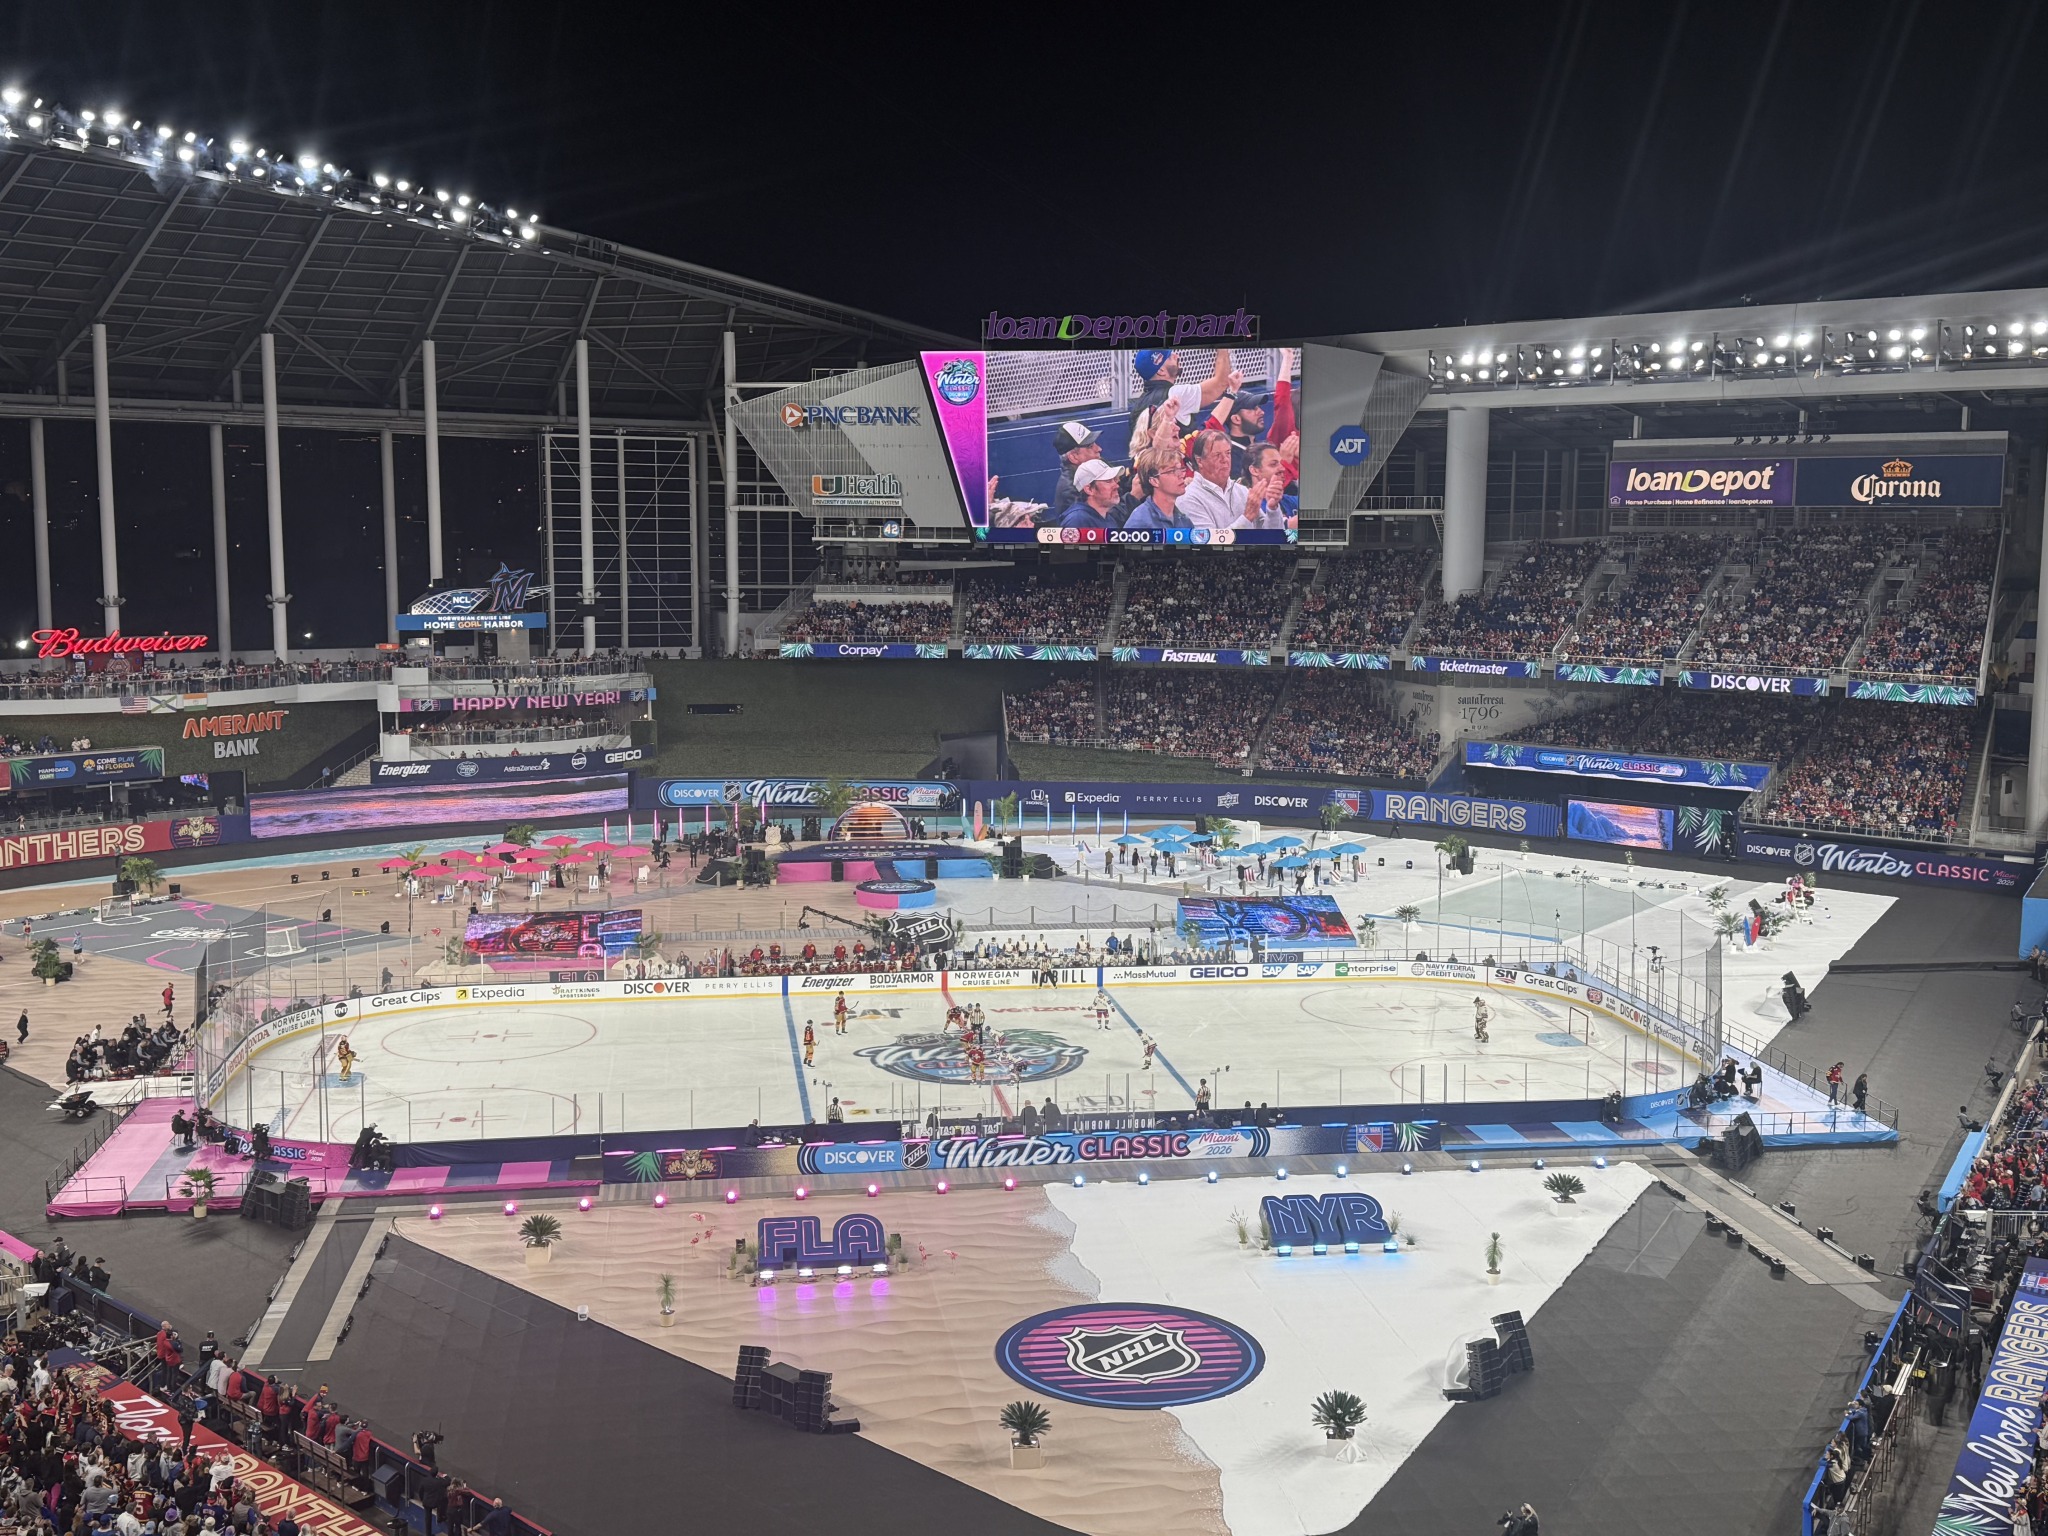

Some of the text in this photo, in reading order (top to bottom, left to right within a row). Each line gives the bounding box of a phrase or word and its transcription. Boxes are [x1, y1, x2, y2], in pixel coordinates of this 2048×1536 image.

[986, 308, 1254, 346] loanDepot park
[934, 371, 980, 388] Winter
[1334, 438, 1366, 454] ADT
[1626, 465, 1775, 497] loanDepot
[1850, 474, 1942, 504] Corona
[884, 524, 898, 534] 42
[1087, 530, 1096, 541] 0
[1110, 530, 1150, 542] 20:00
[1174, 530, 1183, 542] 0
[1219, 535, 1226, 543] 0
[452, 596, 471, 604] NCL
[484, 620, 524, 628] HARBOR
[32, 628, 208, 659] Budweiser
[1440, 660, 1508, 675] ticketmaster
[1710, 674, 1791, 693] DISCOVER
[452, 697, 520, 711] HAPPY
[527, 694, 568, 709] NEW
[572, 691, 620, 706] YEAR!
[183, 710, 285, 738] AMERANT
[214, 738, 260, 758] BANK
[604, 750, 642, 764] GEICO
[1577, 755, 1621, 771] Winter
[1622, 761, 1660, 773] CLASSIC
[379, 764, 431, 778] Energizer
[674, 788, 718, 798] DISCOVER
[911, 787, 941, 796] Miami
[1078, 792, 1120, 803] Expedia
[1254, 796, 1308, 808] DISCOVER
[1386, 794, 1527, 832] RANGERS
[1747, 844, 1791, 858] DISCOVER
[1817, 844, 1914, 878] Winter
[1916, 862, 1990, 882] CLASSIC
[1993, 870, 2020, 880] Miami
[954, 971, 1020, 980] NORWEGIAN
[1124, 969, 1177, 979] MassMutual
[1190, 966, 1248, 979] GEICO
[1262, 966, 1282, 976] SAP
[1298, 966, 1317, 976] SAP
[1338, 964, 1397, 976] enterprise
[802, 976, 854, 990] Energizer
[870, 973, 935, 985] BODYARMOR
[1524, 975, 1578, 995] Great Clips
[472, 986, 525, 1000] Expedia
[624, 982, 690, 995] DISCOVER
[372, 992, 440, 1008] Great Clips
[335, 1006, 348, 1015] TNT
[1620, 1004, 1650, 1029] DISCOVER
[272, 1008, 322, 1030] NORWEGIAN
[278, 1018, 315, 1035] CRUISE LINE
[273, 1146, 306, 1160] ASSIC
[825, 1131, 1239, 1169] DISCOVER NHL Winter CLASSIC Miami 2026
[1263, 1195, 1387, 1239] NYR
[760, 1215, 883, 1261] FLA
[1100, 1331, 1166, 1374] NHL
[1967, 1403, 2036, 1466] York
[1955, 1454, 2020, 1524] New
[136, 1500, 143, 1515] 5
